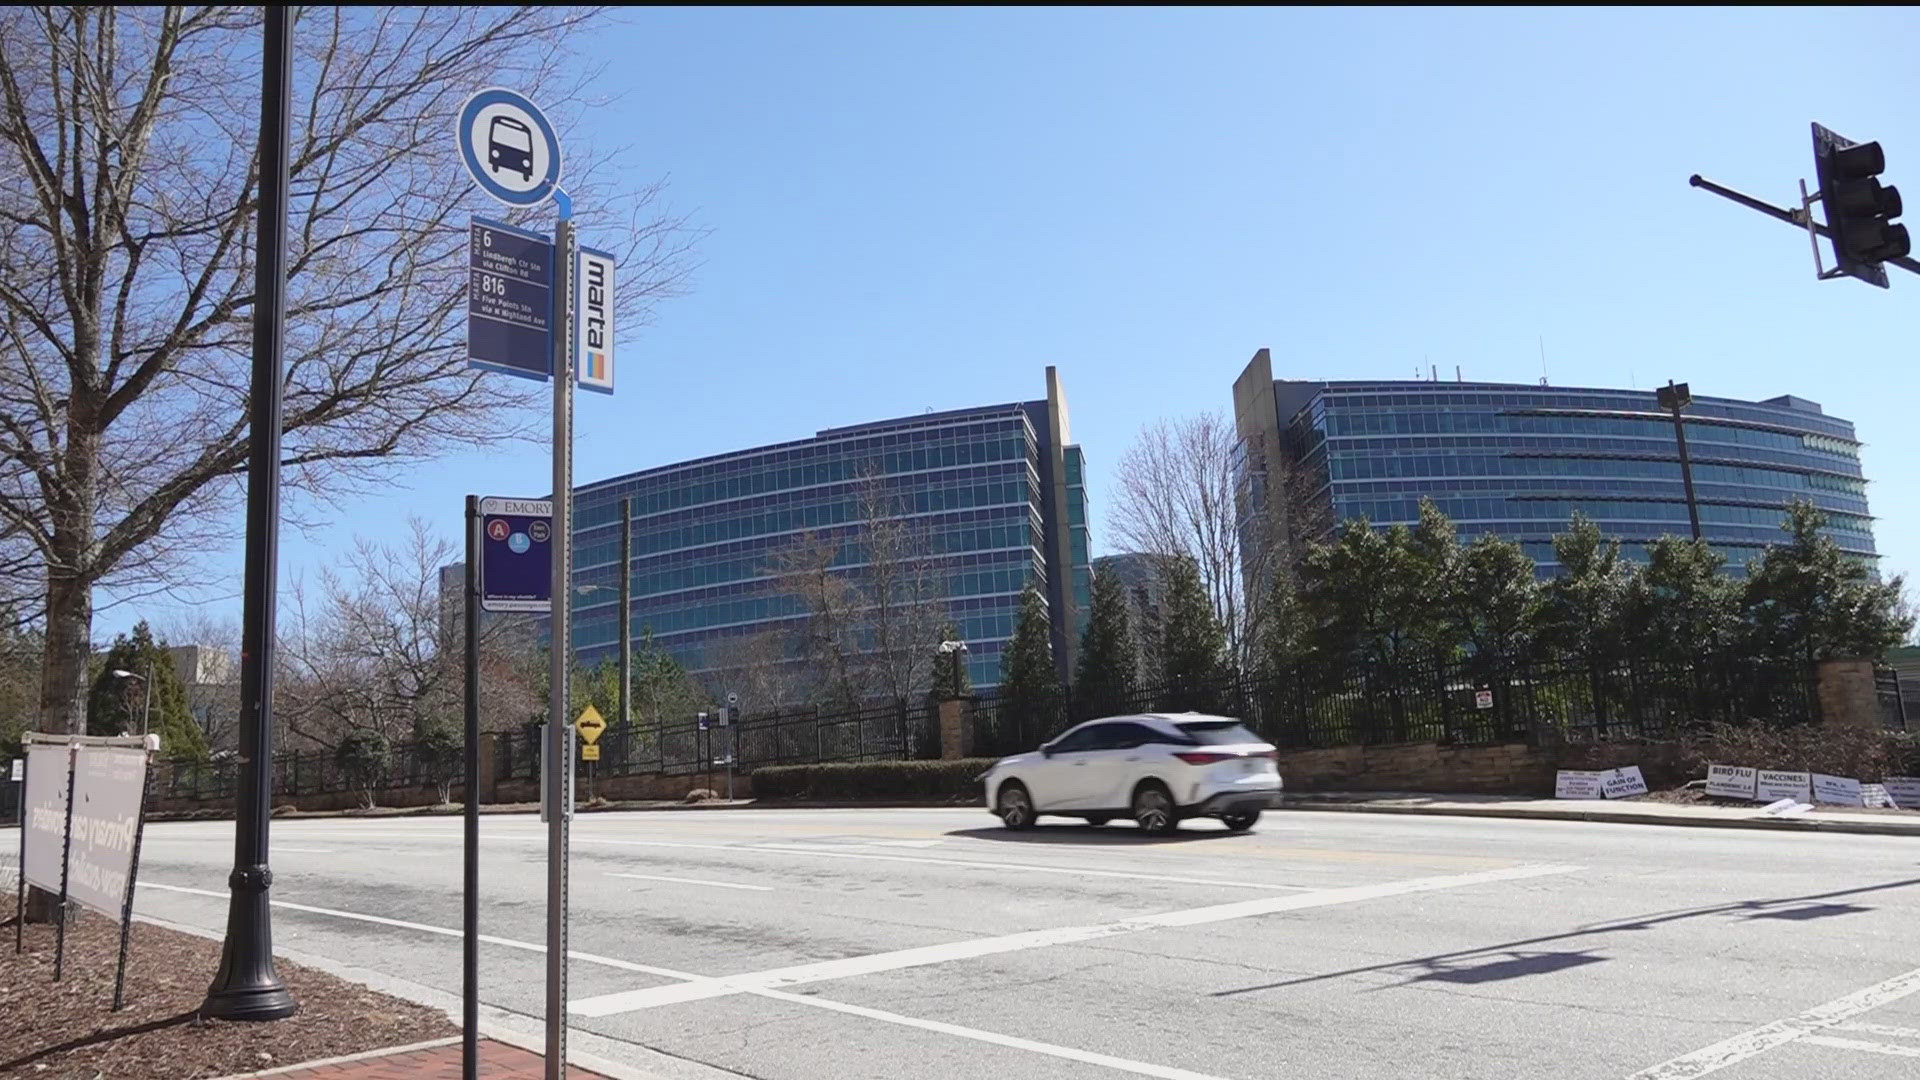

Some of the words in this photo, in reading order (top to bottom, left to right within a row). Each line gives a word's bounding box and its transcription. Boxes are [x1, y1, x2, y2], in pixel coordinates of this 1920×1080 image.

[483, 230, 492, 247] 6
[482, 260, 494, 269] via
[495, 262, 518, 275] Clifton
[519, 269, 529, 278] Rd
[483, 251, 517, 266] Lindbergh
[519, 259, 529, 268] Ctr
[531, 262, 541, 271] Stn
[473, 272, 481, 301] MARTA
[482, 275, 505, 296] 816
[482, 295, 496, 305] Five
[498, 299, 519, 310] Points
[521, 303, 532, 313] Stn
[587, 260, 605, 349] marta
[481, 304, 493, 314] via
[494, 307, 501, 316] N
[533, 317, 545, 326] Ave
[505, 502, 551, 514] EMORY
[494, 524, 504, 536] A
[1627, 776, 1638, 784] OF
[1712, 767, 1734, 776] BIRD
[1735, 769, 1752, 778] FLU
[1605, 784, 1644, 794] FUNCTION
